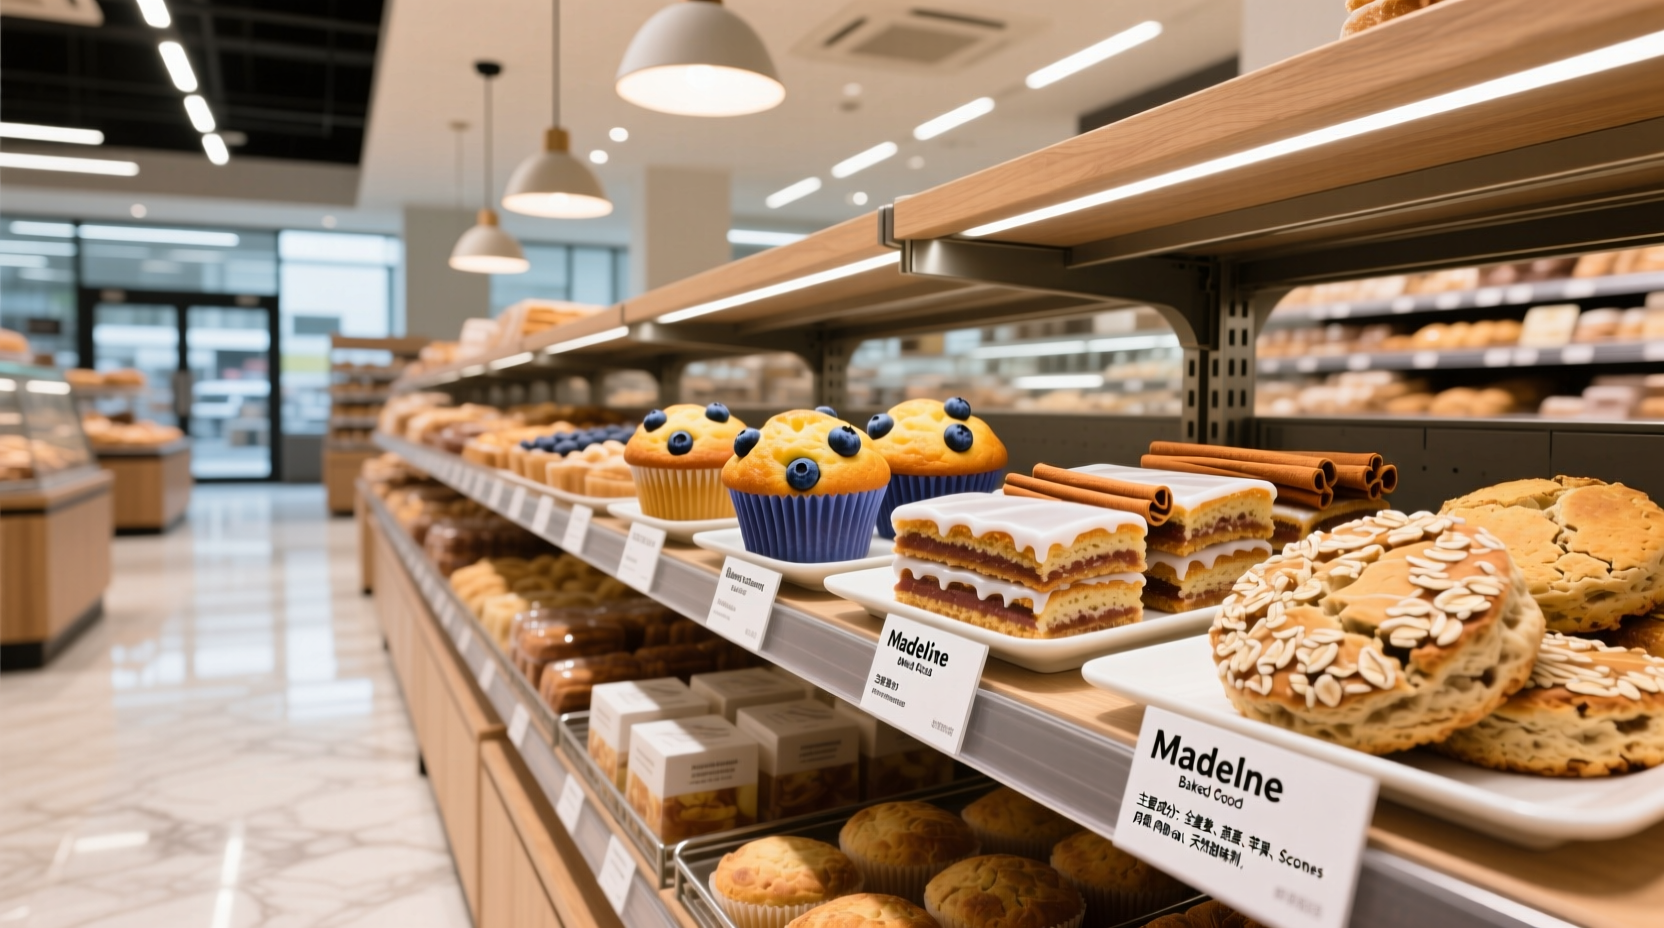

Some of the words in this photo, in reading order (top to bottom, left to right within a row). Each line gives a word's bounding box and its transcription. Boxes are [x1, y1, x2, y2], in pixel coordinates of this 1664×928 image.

[1150, 729, 1283, 803] Madelne
[1178, 775, 1211, 798] Baked
[1278, 848, 1323, 878] Scones
